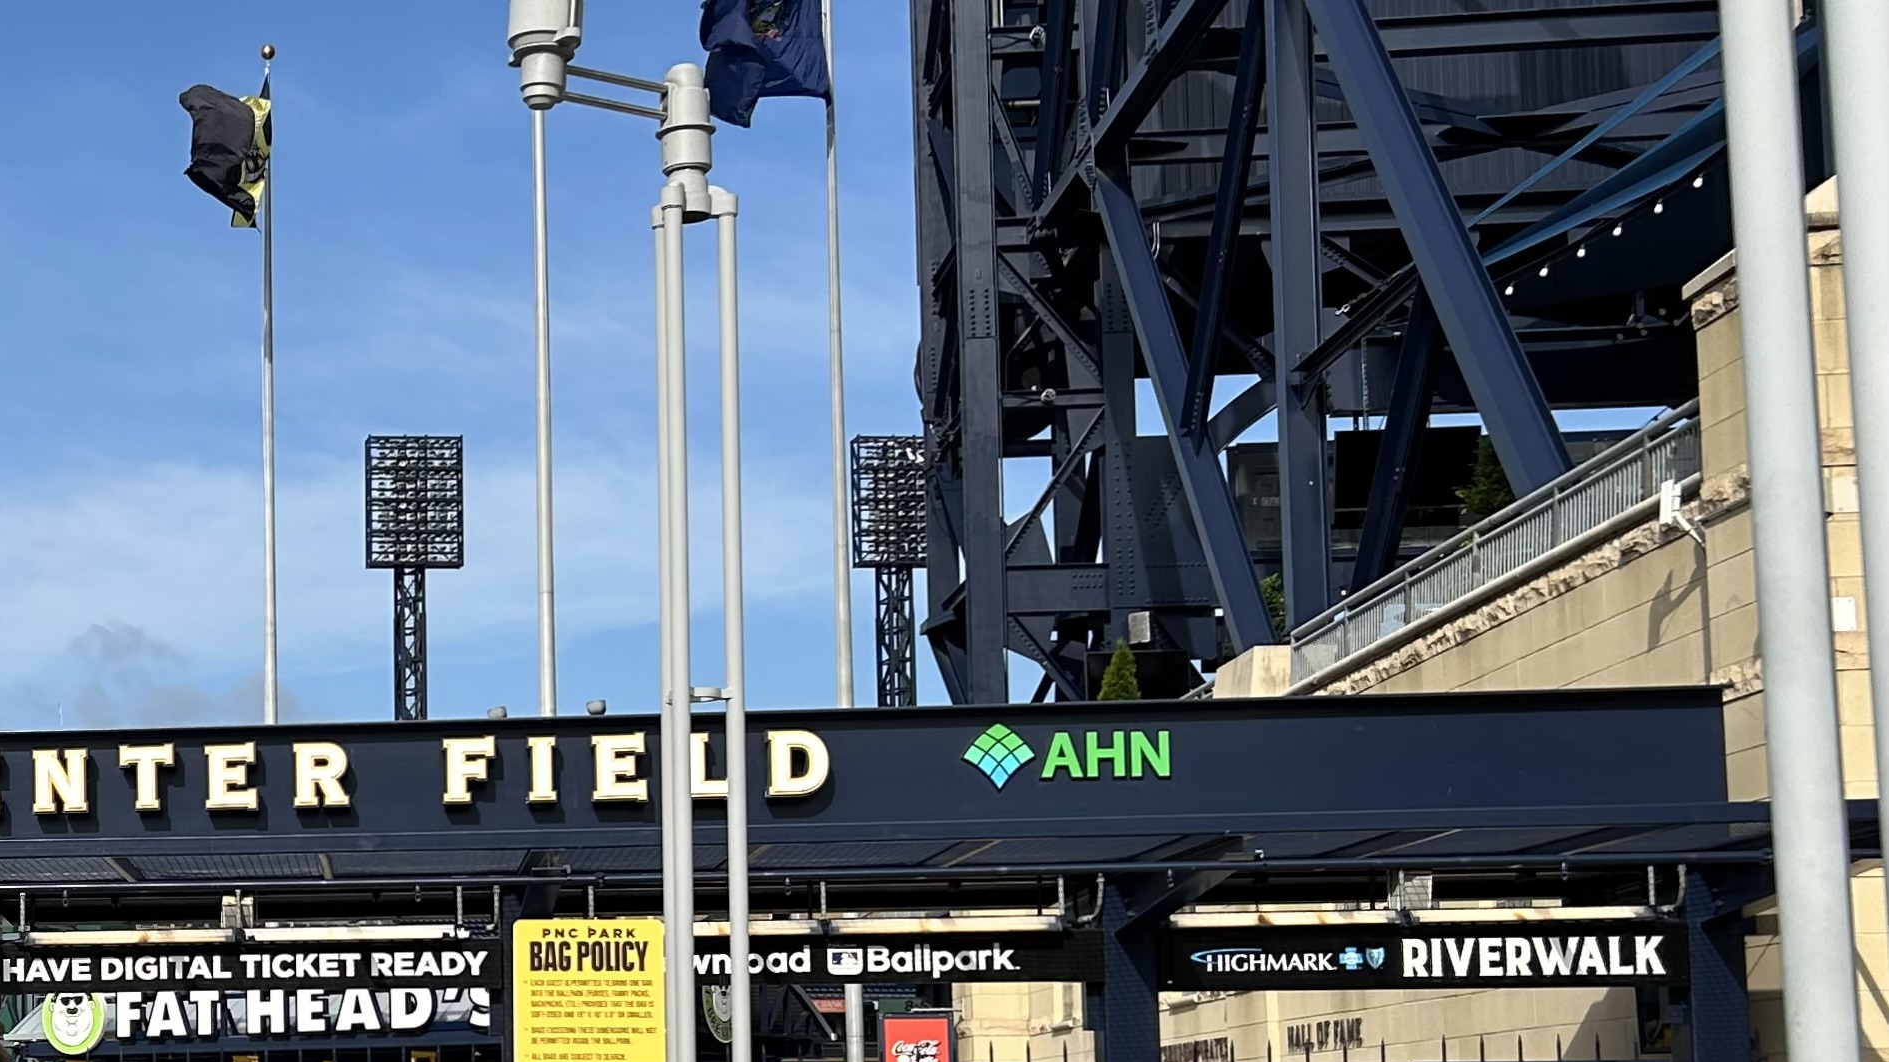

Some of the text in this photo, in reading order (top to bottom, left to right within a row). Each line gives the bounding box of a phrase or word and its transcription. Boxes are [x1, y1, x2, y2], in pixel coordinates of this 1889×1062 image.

[440, 728, 831, 806] FIELD
[1040, 729, 1172, 780] AHN
[542, 928, 636, 939] PNC PARK
[2, 949, 488, 983] HAVE DIGITAL TICKET READY
[529, 940, 649, 972] BAG POLICY
[1205, 950, 1333, 973] HIGHMARK
[1401, 934, 1668, 978] RIVERWALK
[115, 988, 217, 1039] FAT
